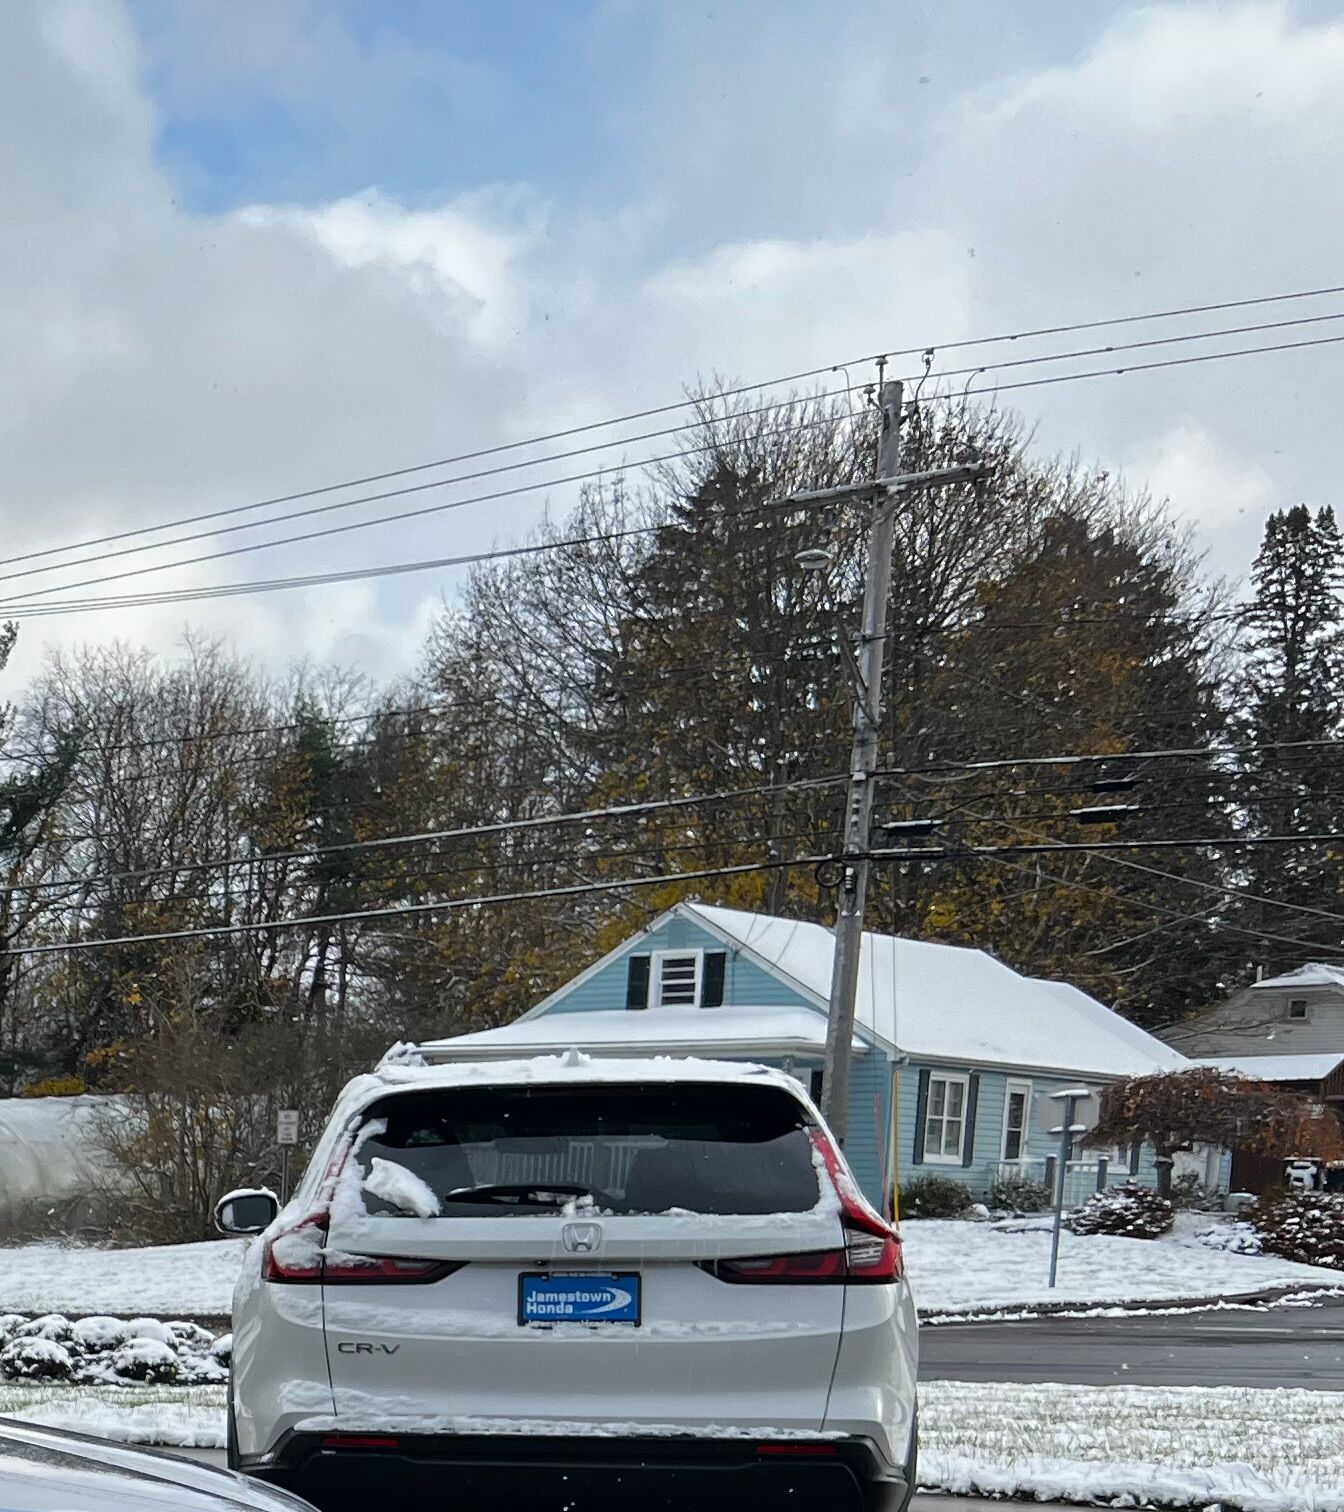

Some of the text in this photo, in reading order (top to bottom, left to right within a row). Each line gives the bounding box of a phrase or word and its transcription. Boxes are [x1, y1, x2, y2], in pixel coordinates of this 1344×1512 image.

[526, 1289, 612, 1302] Jamestown
[525, 1302, 573, 1315] Honda
[337, 1342, 402, 1355] CR-V
